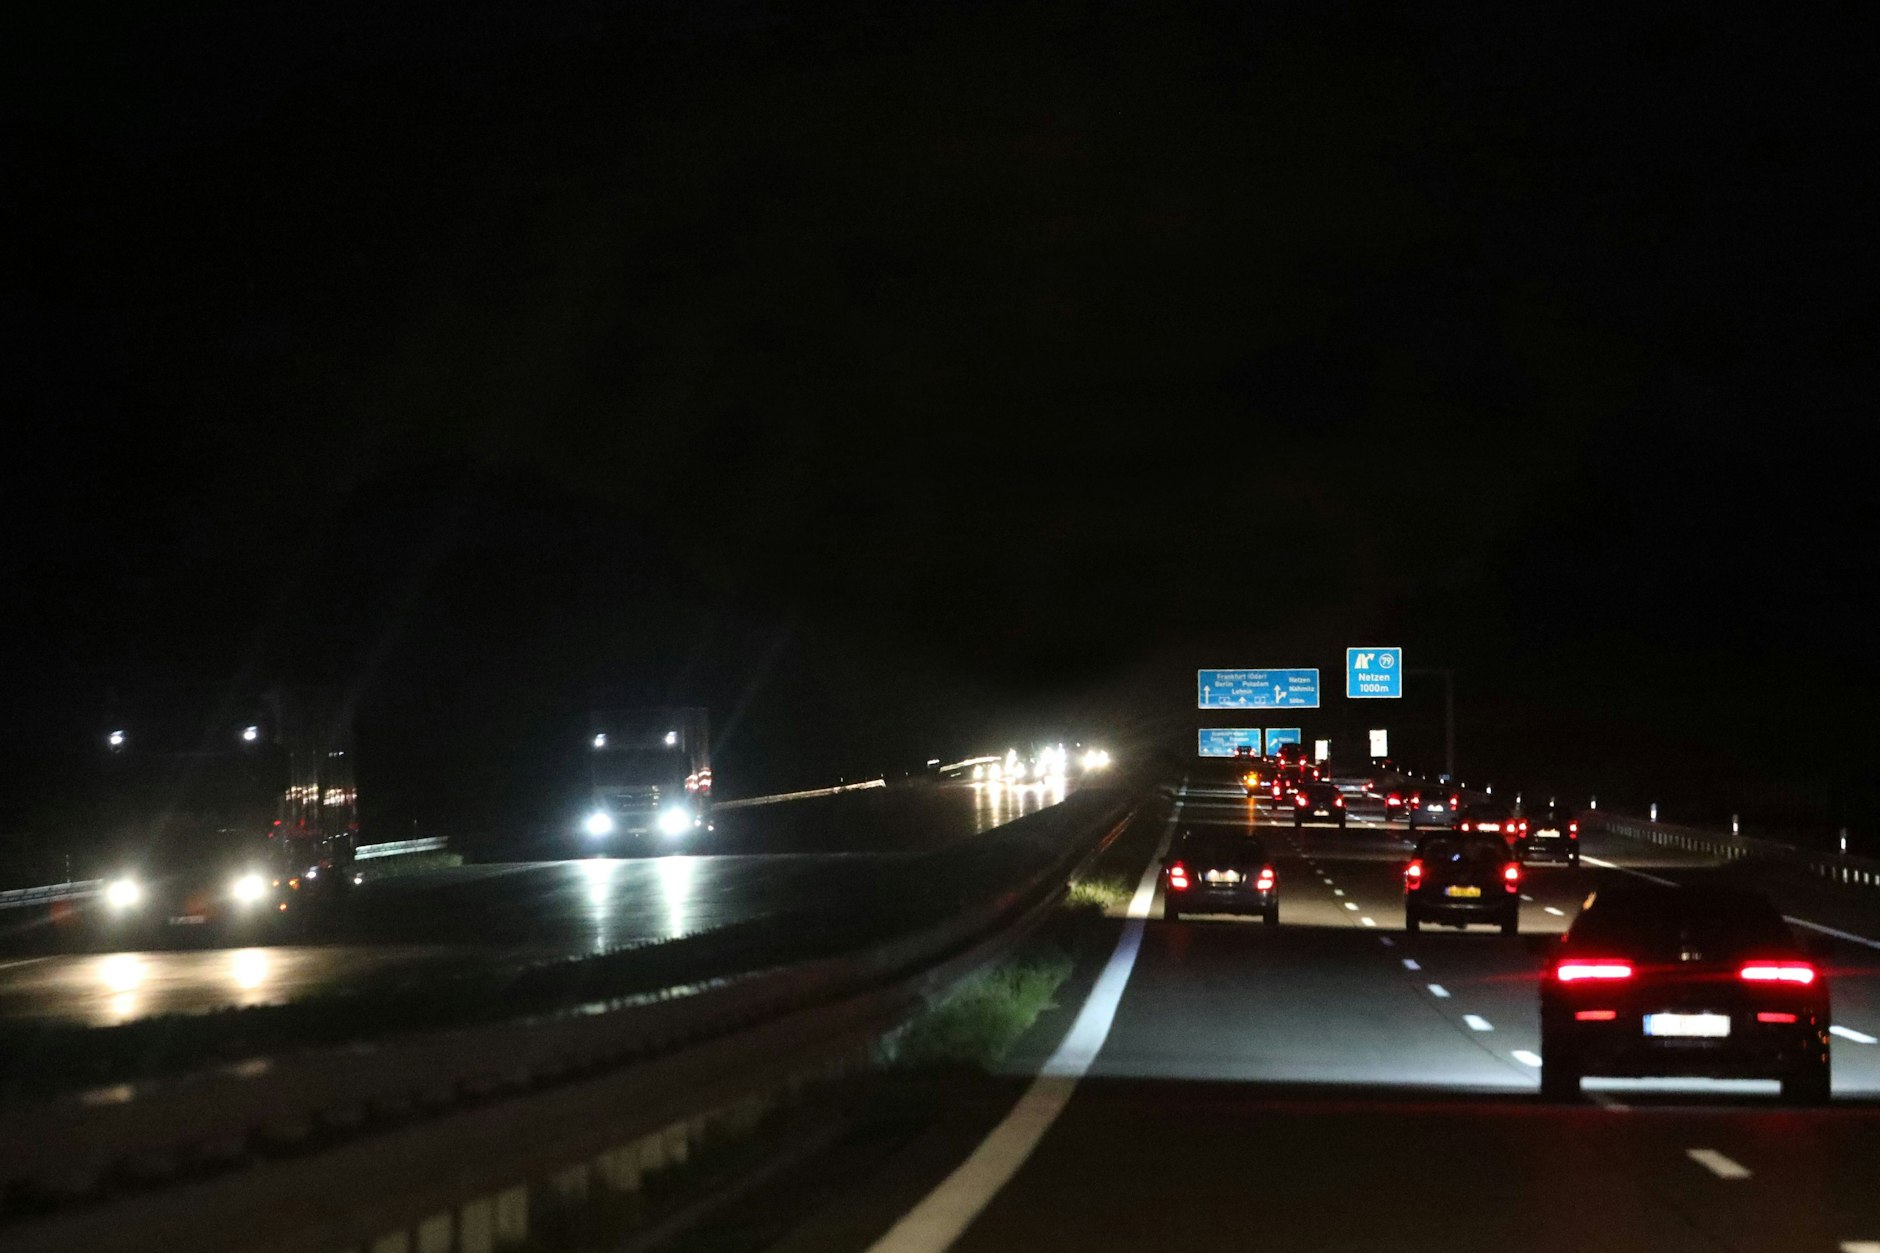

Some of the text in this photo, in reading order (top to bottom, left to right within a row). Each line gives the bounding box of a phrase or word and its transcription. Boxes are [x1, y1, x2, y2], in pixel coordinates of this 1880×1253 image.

[1382, 657, 1392, 665] 79
[1358, 673, 1390, 681] Netzen
[1360, 684, 1389, 692] 1000m
